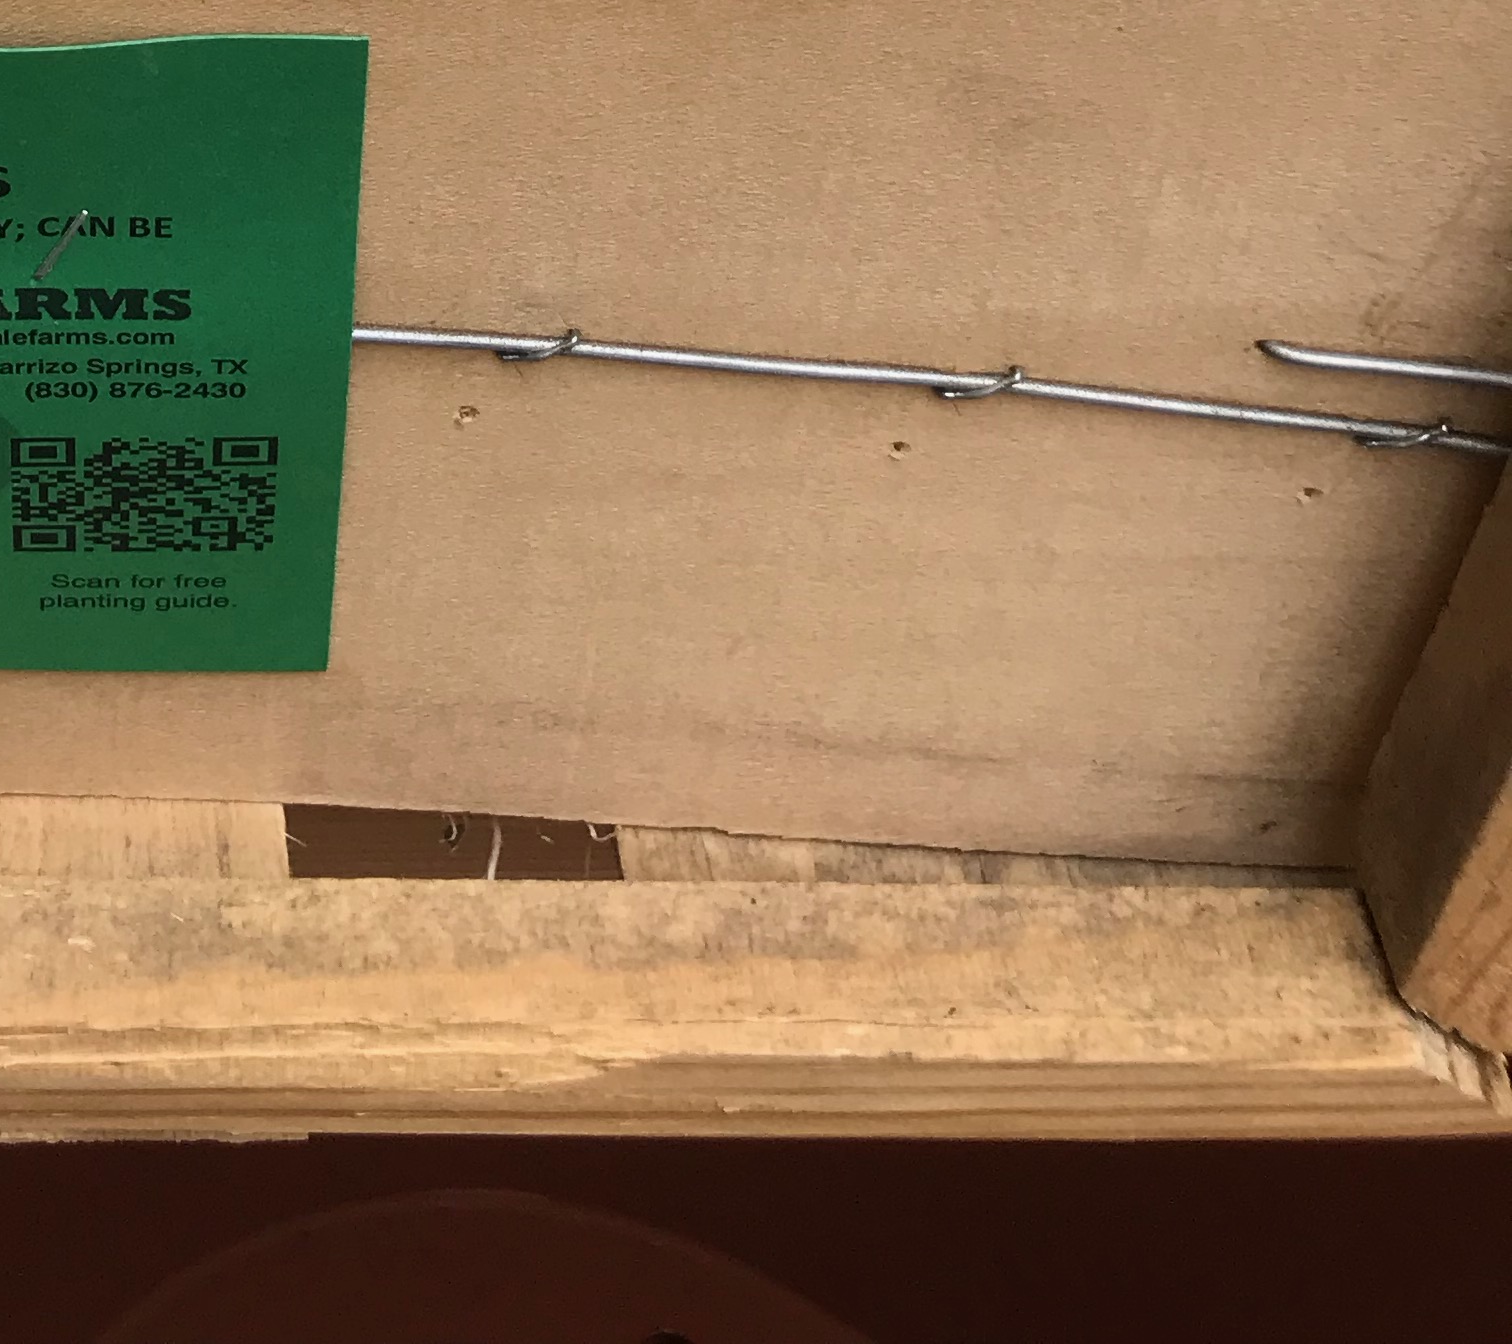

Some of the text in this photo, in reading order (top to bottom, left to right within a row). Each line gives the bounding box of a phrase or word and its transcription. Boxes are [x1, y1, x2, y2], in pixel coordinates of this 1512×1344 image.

[38, 216, 115, 238] CAN
[129, 216, 173, 238] BE
[87, 358, 202, 378] Springs,
[212, 358, 248, 375] TX
[24, 381, 247, 402] (830) 876-2430
[51, 573, 227, 588] Scan for free
[39, 592, 238, 612] planting guide.
